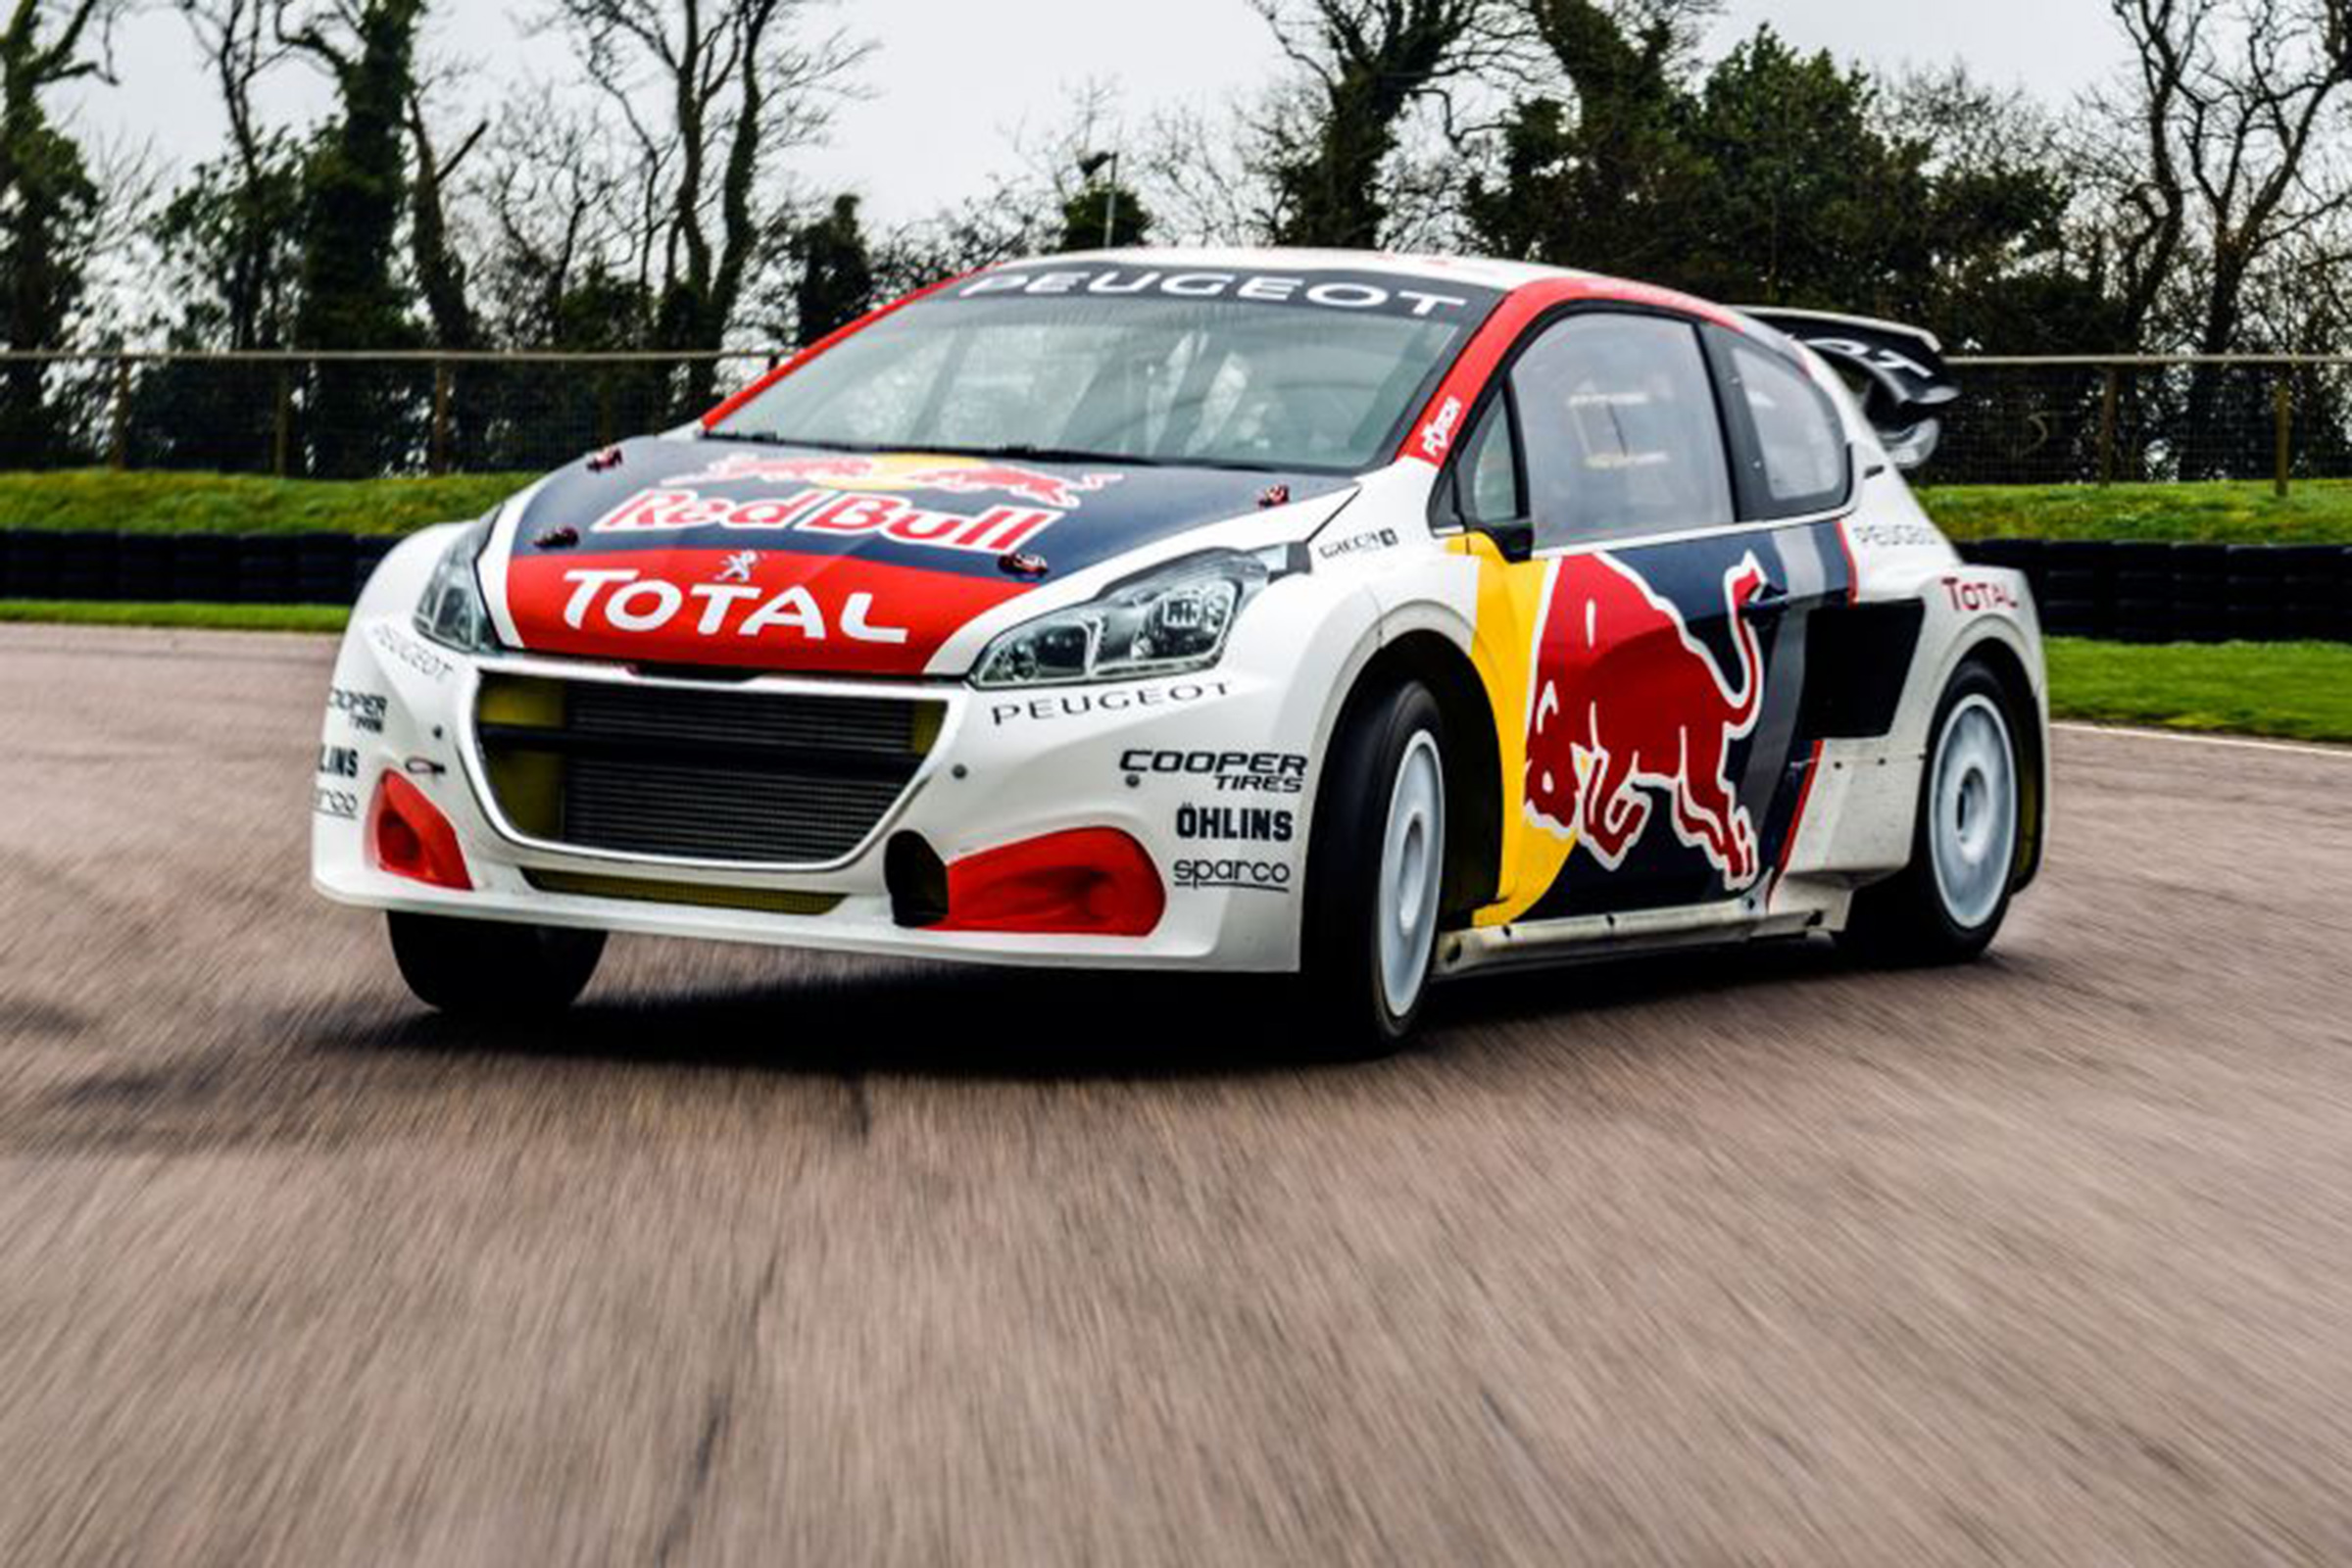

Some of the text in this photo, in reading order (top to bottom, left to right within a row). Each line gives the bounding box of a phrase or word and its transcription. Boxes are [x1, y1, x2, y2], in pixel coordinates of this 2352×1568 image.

[958, 270, 1466, 316] PEUGEOT
[592, 489, 1066, 556] Red Bull
[562, 567, 906, 644] TOTAL
[1941, 576, 2019, 611] TOTAL
[991, 682, 1232, 726] PEUGEOT
[1119, 749, 1308, 777] COOPER
[1213, 774, 1304, 794] TIRES
[1176, 803, 1294, 842] ÖHLINS
[1173, 858, 1291, 890] sparco
